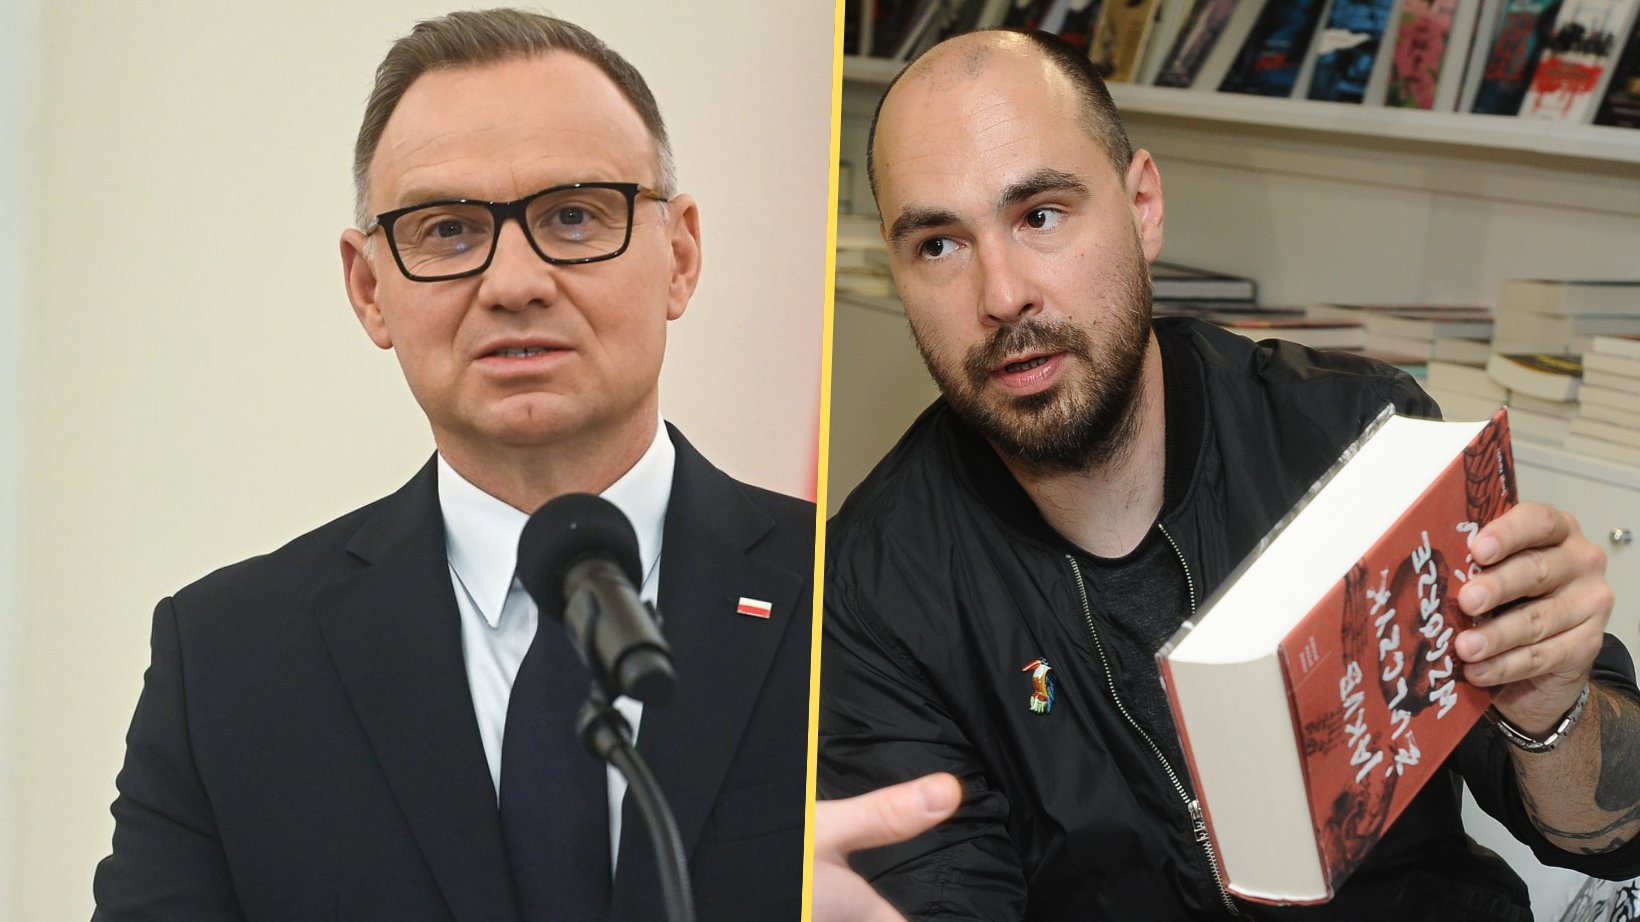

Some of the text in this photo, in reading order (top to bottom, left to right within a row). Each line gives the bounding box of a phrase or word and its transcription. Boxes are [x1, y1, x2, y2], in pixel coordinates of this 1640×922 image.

[1366, 568, 1421, 778] ŻULCZYK
[1411, 530, 1458, 720] WZGÓRZE
[1339, 660, 1384, 784] JAKUB
